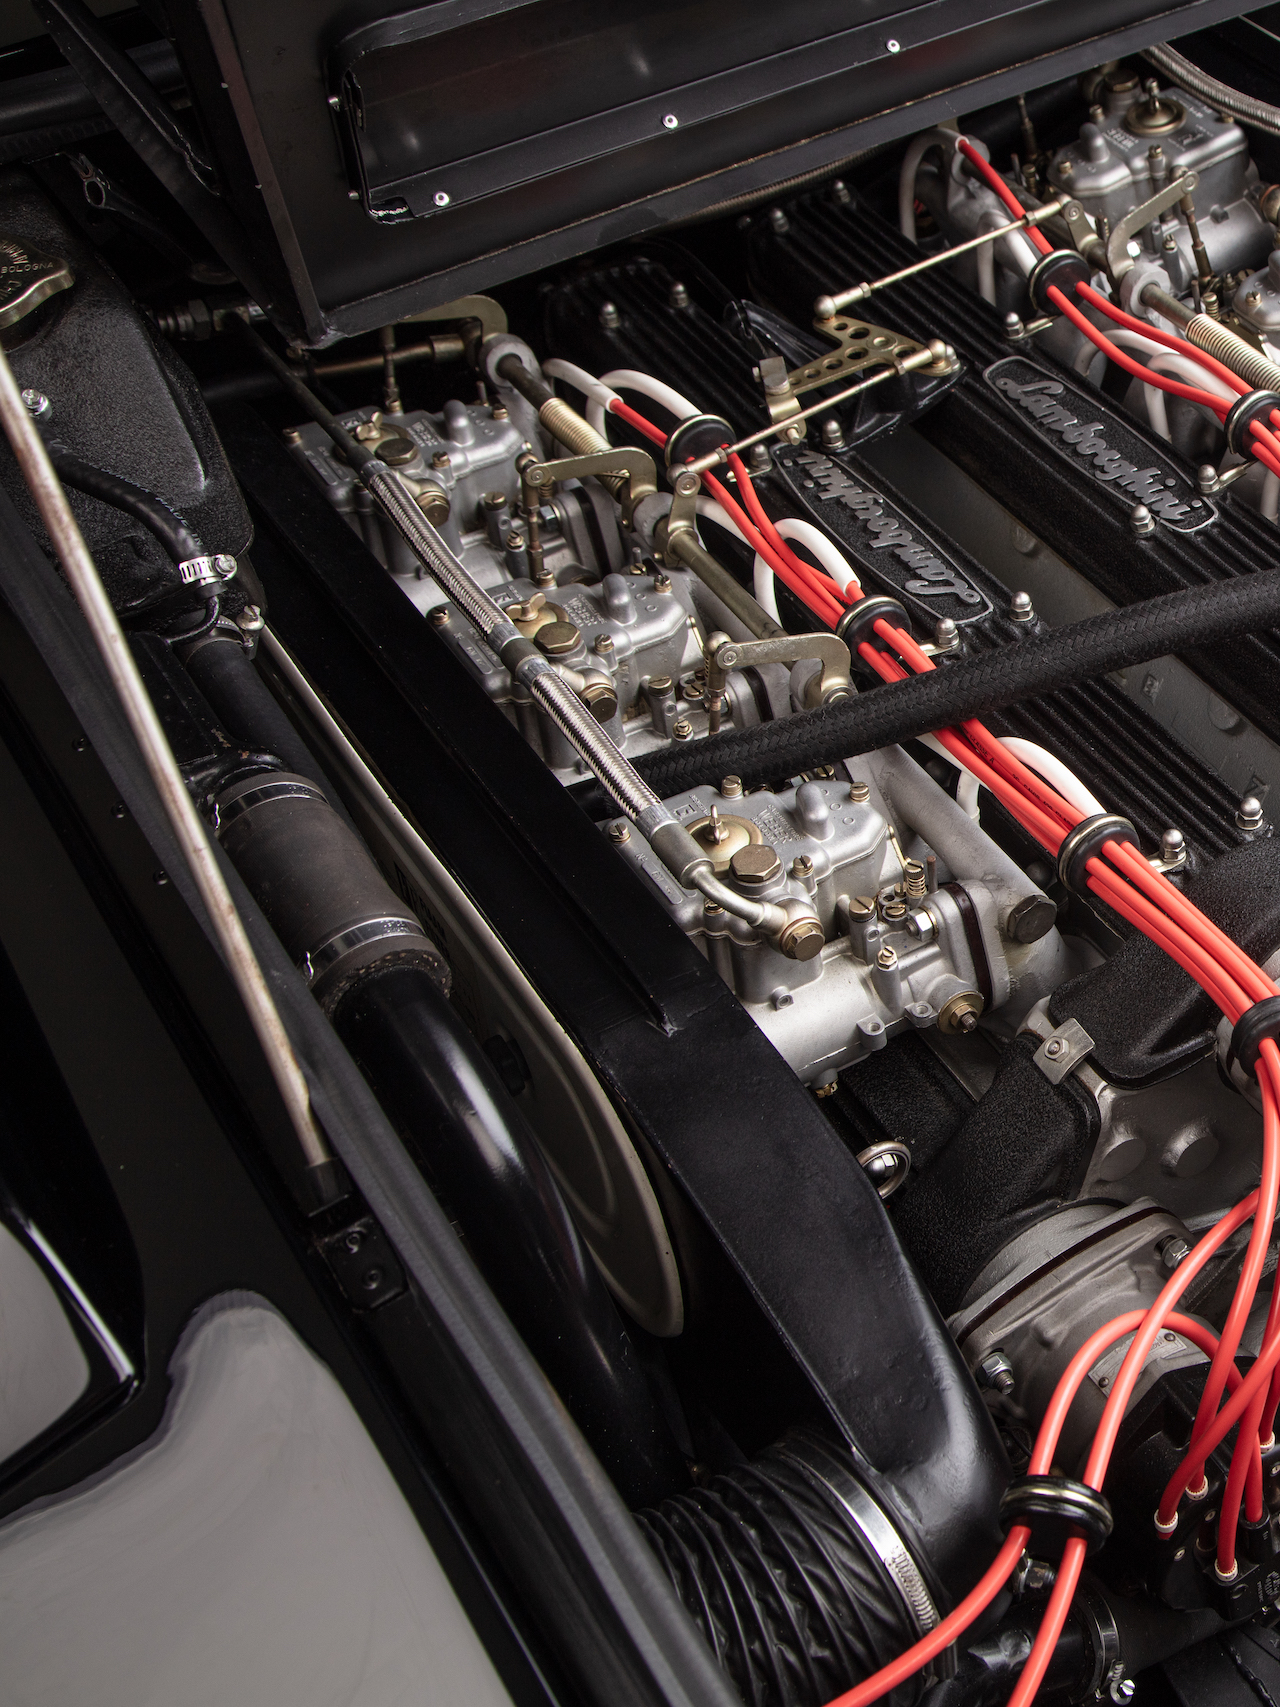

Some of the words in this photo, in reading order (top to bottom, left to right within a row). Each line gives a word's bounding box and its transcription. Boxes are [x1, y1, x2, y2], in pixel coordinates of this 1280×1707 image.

[998, 376, 1203, 522] Lamborghini
[781, 449, 982, 602] Lamborghini
[757, 808, 793, 845] WEBER
